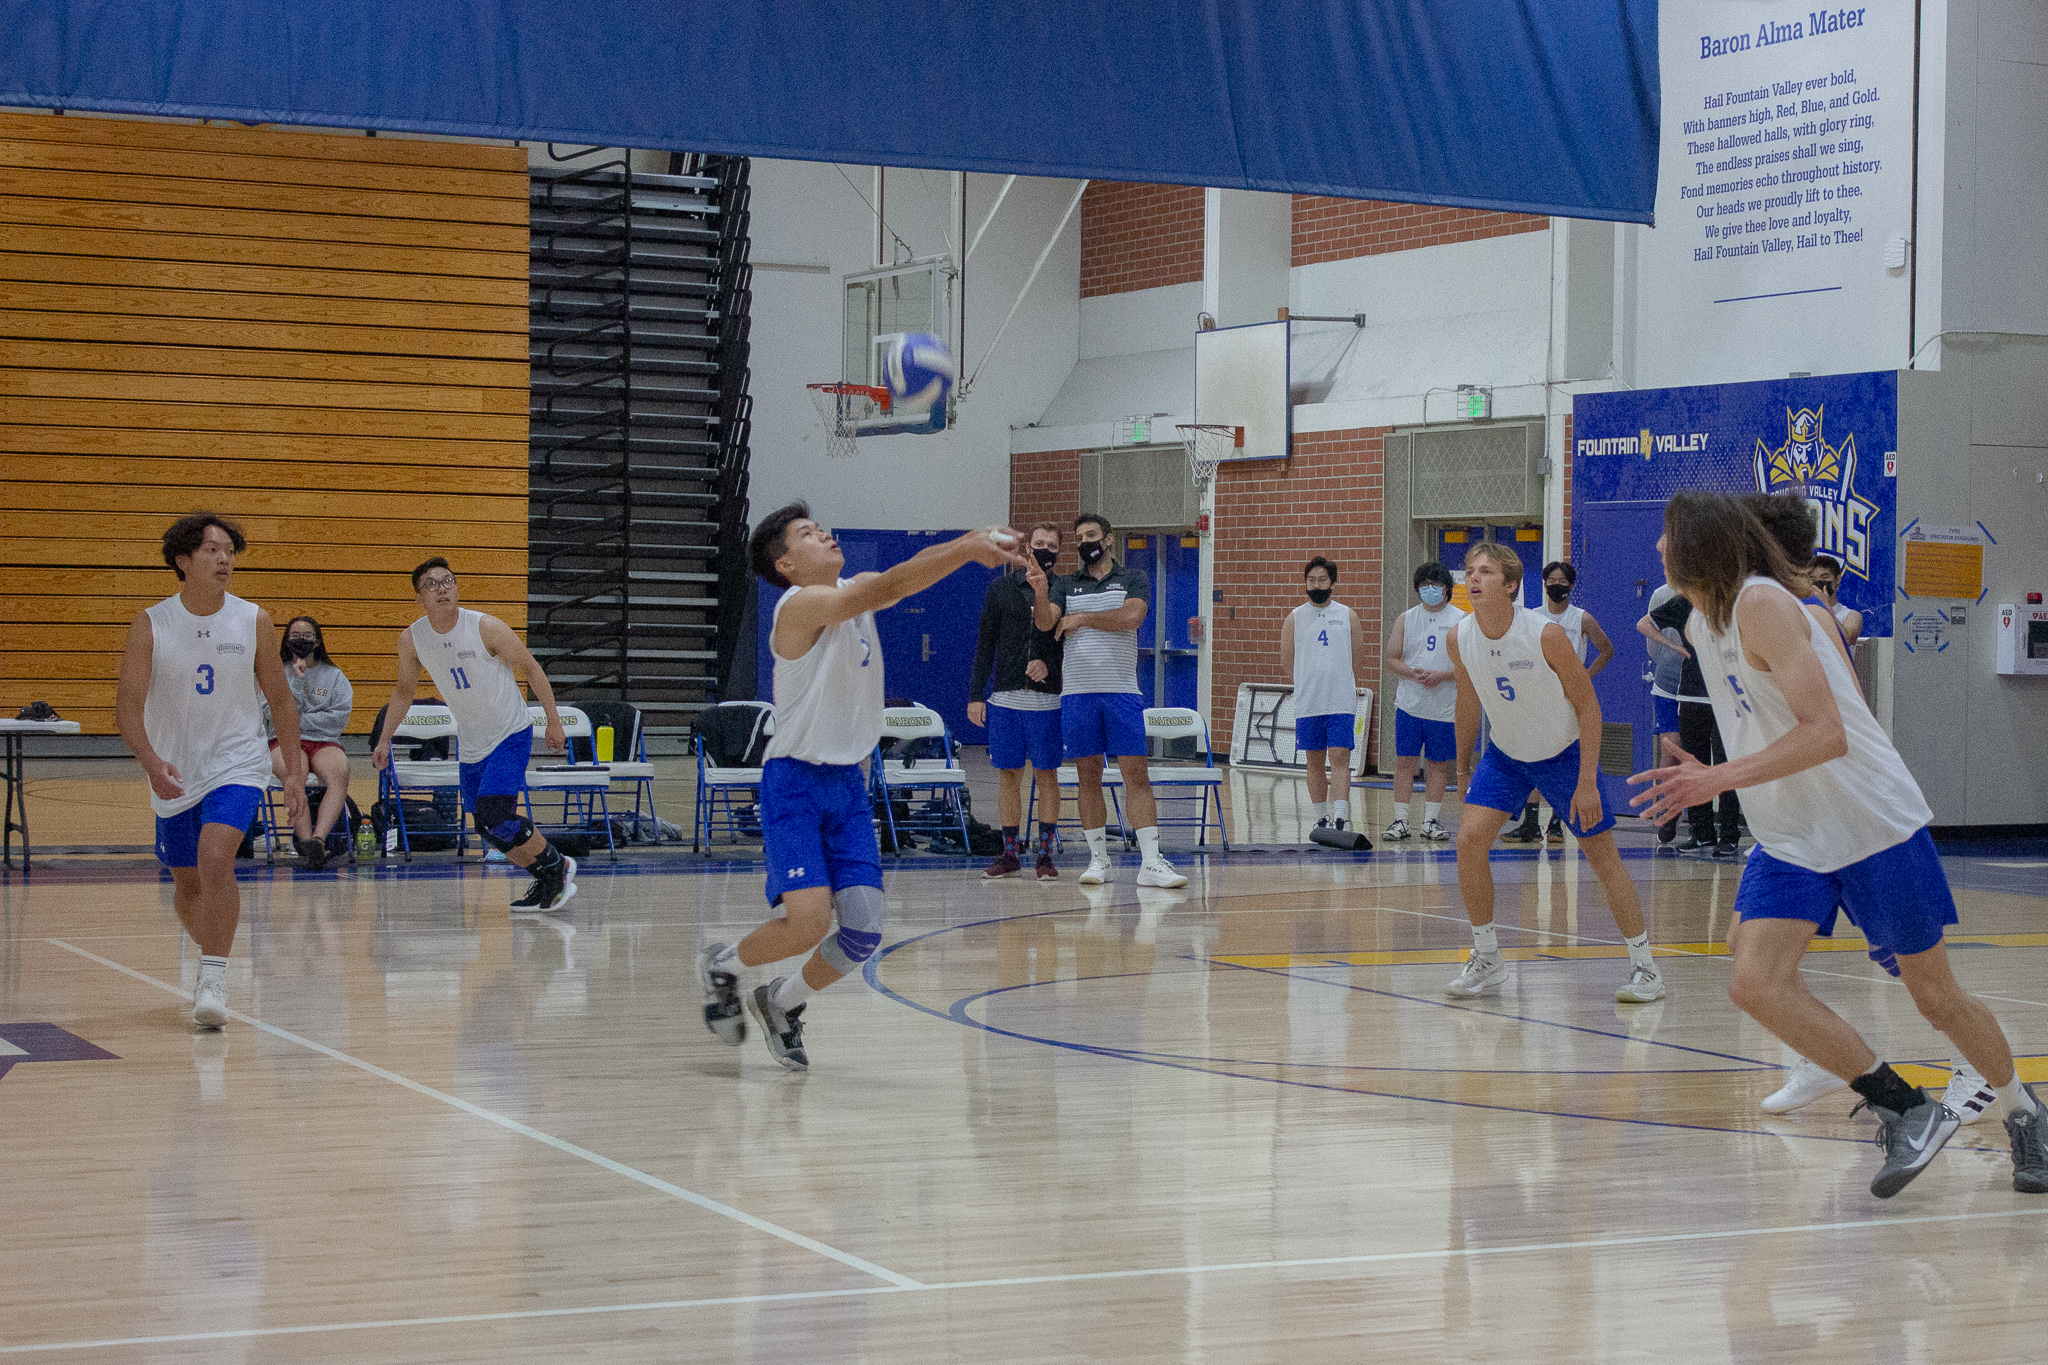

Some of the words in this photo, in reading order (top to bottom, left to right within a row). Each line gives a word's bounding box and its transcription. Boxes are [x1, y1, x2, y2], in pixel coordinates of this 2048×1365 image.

[1700, 33, 1751, 60] Baron
[1755, 21, 1804, 48] Alma
[1809, 8, 1866, 37] Mater
[1704, 93, 1724, 110] Hail
[1726, 86, 1769, 106] Fountain
[1772, 80, 1803, 96] Valley
[1805, 77, 1828, 91] ever
[1830, 68, 1857, 86] bold,
[1683, 119, 1705, 135] With
[1707, 115, 1747, 131] banners
[1749, 107, 1773, 125] high,
[1776, 102, 1798, 118] Red,
[1801, 99, 1826, 114] Blue,
[1829, 92, 1849, 109] and
[1852, 87, 1880, 105] Gold.
[1687, 141, 1715, 155] These
[1717, 130, 1762, 150] hallowed
[1764, 126, 1790, 142] halls,
[1793, 121, 1817, 137] with
[1819, 118, 1847, 136] glory
[1849, 113, 1874, 129] ring,
[1696, 161, 1714, 175] The
[1716, 156, 1752, 172] endless
[1755, 150, 1790, 169] praises
[1792, 143, 1817, 160] shall
[1819, 143, 1835, 156] we
[1838, 138, 1864, 154] sing,
[1680, 183, 1704, 200] Fond
[1706, 177, 1753, 196] memories
[1755, 173, 1779, 188] echo
[1781, 164, 1840, 184] throughout
[1842, 160, 1882, 175] history.
[1696, 205, 1714, 219] Our
[1716, 199, 1745, 216] heads
[1747, 200, 1762, 211] we
[1764, 191, 1803, 212] proudly
[1805, 188, 1820, 203] lift
[1823, 188, 1834, 201] to
[1836, 184, 1863, 199] thee.
[1705, 225, 1720, 239] We
[1722, 222, 1743, 240] give
[1745, 219, 1766, 234] thee
[1768, 217, 1789, 230] love
[1792, 211, 1811, 227] and
[1814, 207, 1852, 226] loyalty,
[1694, 246, 1713, 262] Hail
[1716, 241, 1759, 259] Fountain
[1761, 237, 1794, 254] Valley,
[1796, 233, 1817, 249] Hail
[1820, 234, 1831, 246] to
[1833, 228, 1863, 244] Thee!
[1577, 437, 1639, 457] FOUNTAIN
[1656, 433, 1709, 452] VALLEY
[1885, 453, 1896, 461] AED
[1809, 485, 1838, 501] VALLEY
[2038, 612, 2048, 620] AE
[1318, 630, 1328, 646] 4
[1426, 635, 1437, 651] 9
[195, 664, 214, 695] 3
[450, 667, 471, 690] 11
[1496, 676, 1516, 701] 5
[311, 688, 328, 696] ASB
[886, 716, 932, 726] BARONS
[1148, 716, 1194, 726] BARONS
[361, 841, 370, 850] G
